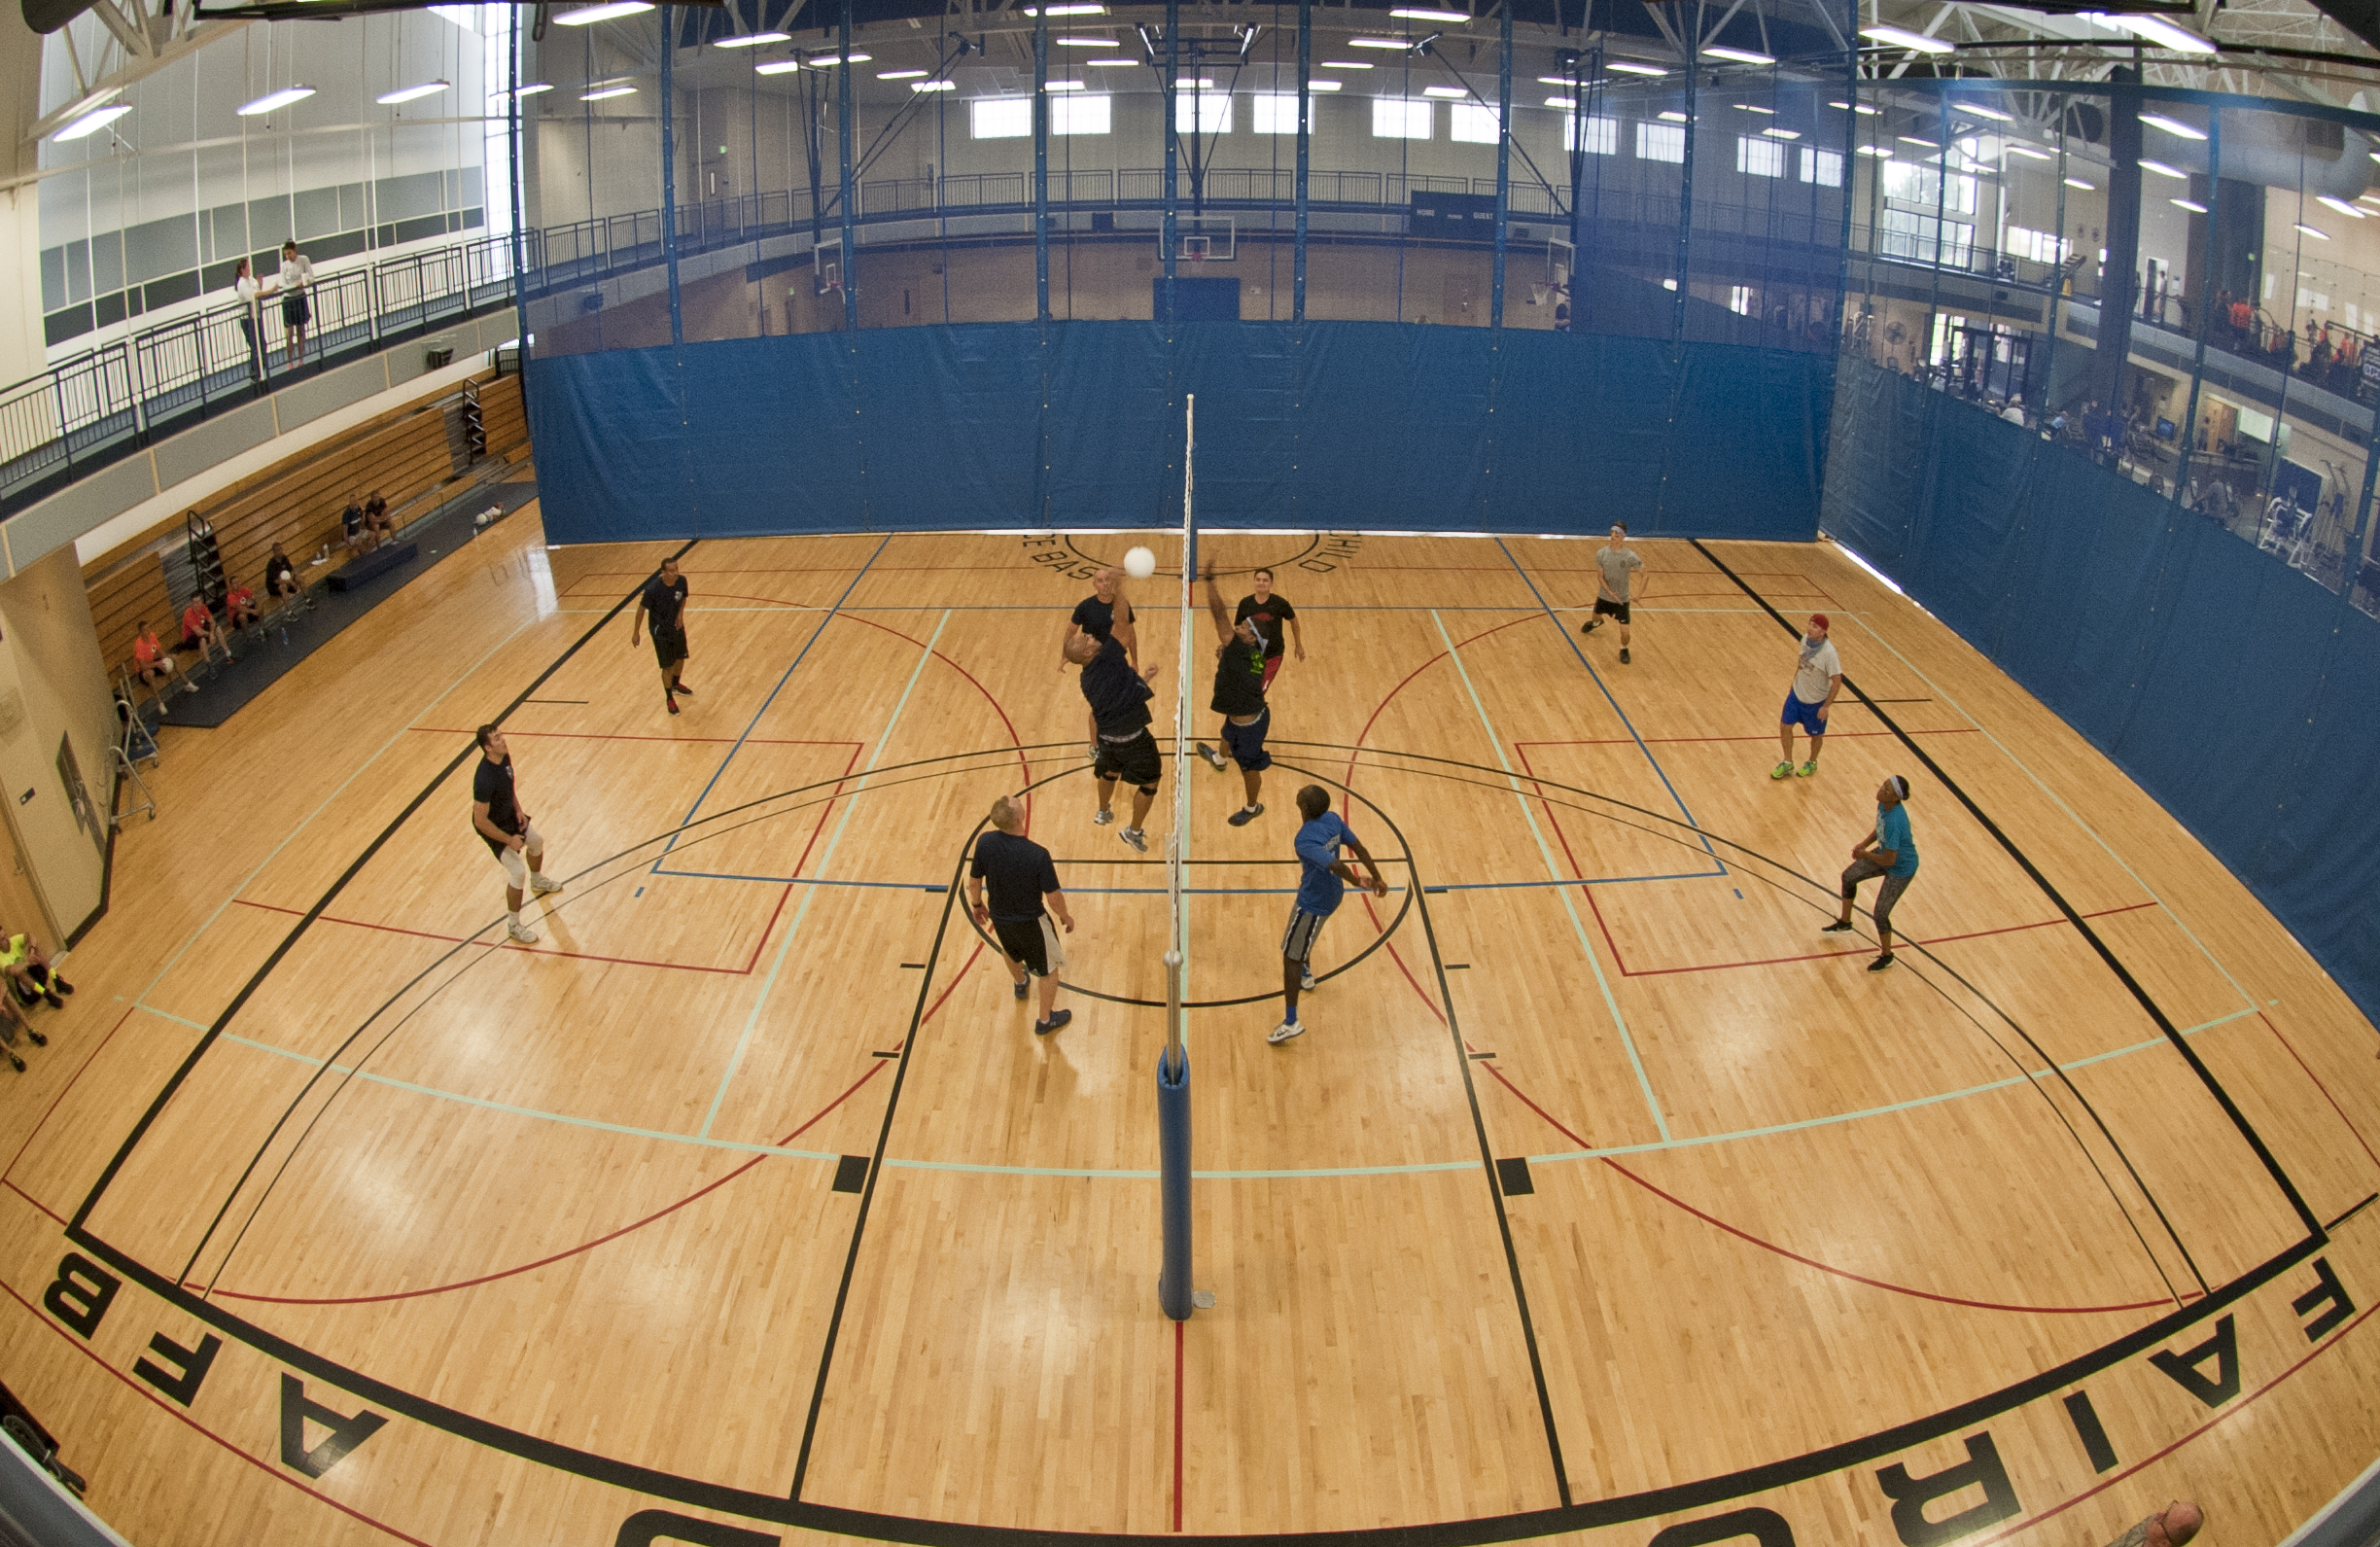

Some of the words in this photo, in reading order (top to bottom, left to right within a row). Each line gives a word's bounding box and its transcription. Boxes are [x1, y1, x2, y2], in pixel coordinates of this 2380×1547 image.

[1032, 550, 1100, 580] BAS
[1298, 533, 1362, 573] HILD
[43, 1251, 390, 1480] AFB
